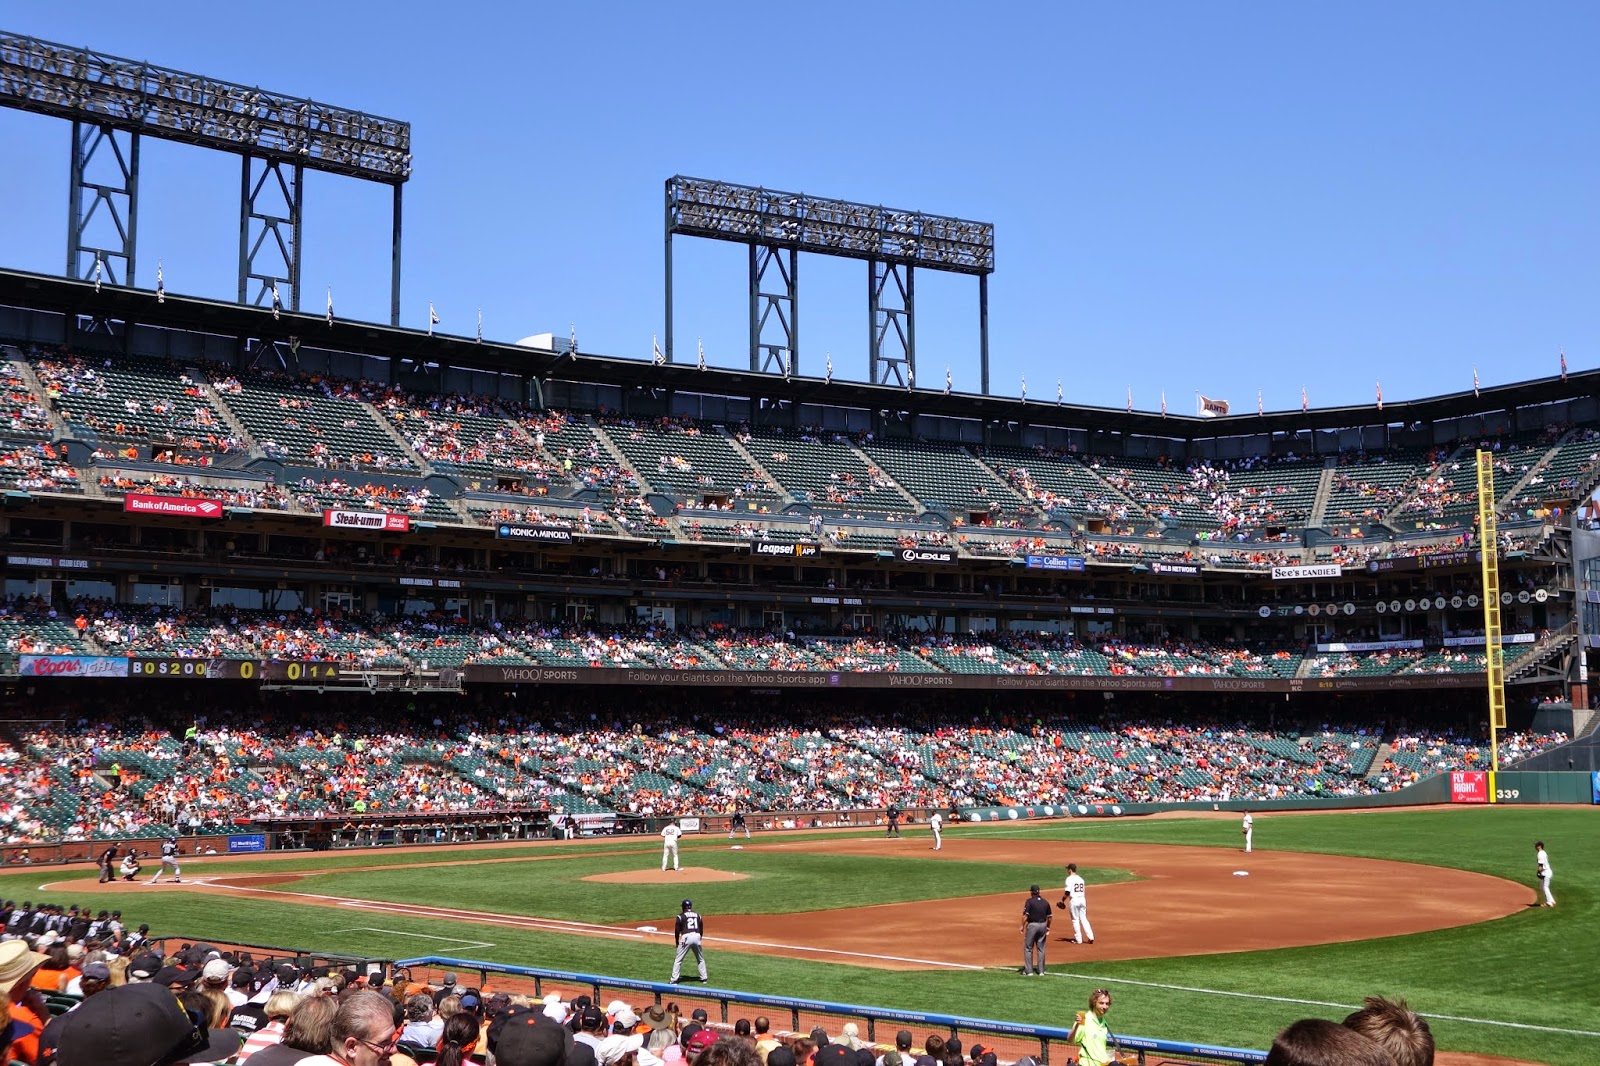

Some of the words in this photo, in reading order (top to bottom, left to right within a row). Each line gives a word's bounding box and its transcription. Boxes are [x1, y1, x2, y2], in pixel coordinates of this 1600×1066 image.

[132, 500, 154, 508] Bank
[154, 501, 163, 510] of
[163, 502, 196, 512] America
[335, 512, 382, 526] Steak-umm
[510, 528, 538, 537] KONICA
[539, 530, 570, 540] MINOLTA
[758, 543, 794, 555] Leapset
[916, 552, 950, 561] LEXUS
[1044, 556, 1067, 566] Colliers
[1275, 569, 1300, 577] See's
[33, 658, 80, 675] Coors
[76, 660, 115, 675] LIGHT
[502, 668, 542, 680] YAHOO!
[544, 670, 577, 680] SPORTS
[628, 672, 657, 680] Follow
[660, 674, 680, 683] your
[682, 673, 711, 682] Giants
[728, 674, 742, 683] the
[745, 674, 774, 683] Yahoo
[776, 674, 806, 684] Sports
[808, 676, 826, 684] app
[888, 675, 923, 686] YAHOO!
[997, 678, 1024, 686] Follow
[1044, 678, 1068, 686] Giants
[1096, 679, 1120, 687] Yahoo
[1122, 679, 1146, 688] Sports
[1453, 773, 1464, 782] FLY
[1454, 783, 1478, 792] RIGHT.
[1496, 789, 1519, 798] 339
[1074, 883, 1084, 892] 28
[687, 918, 698, 929] 21
